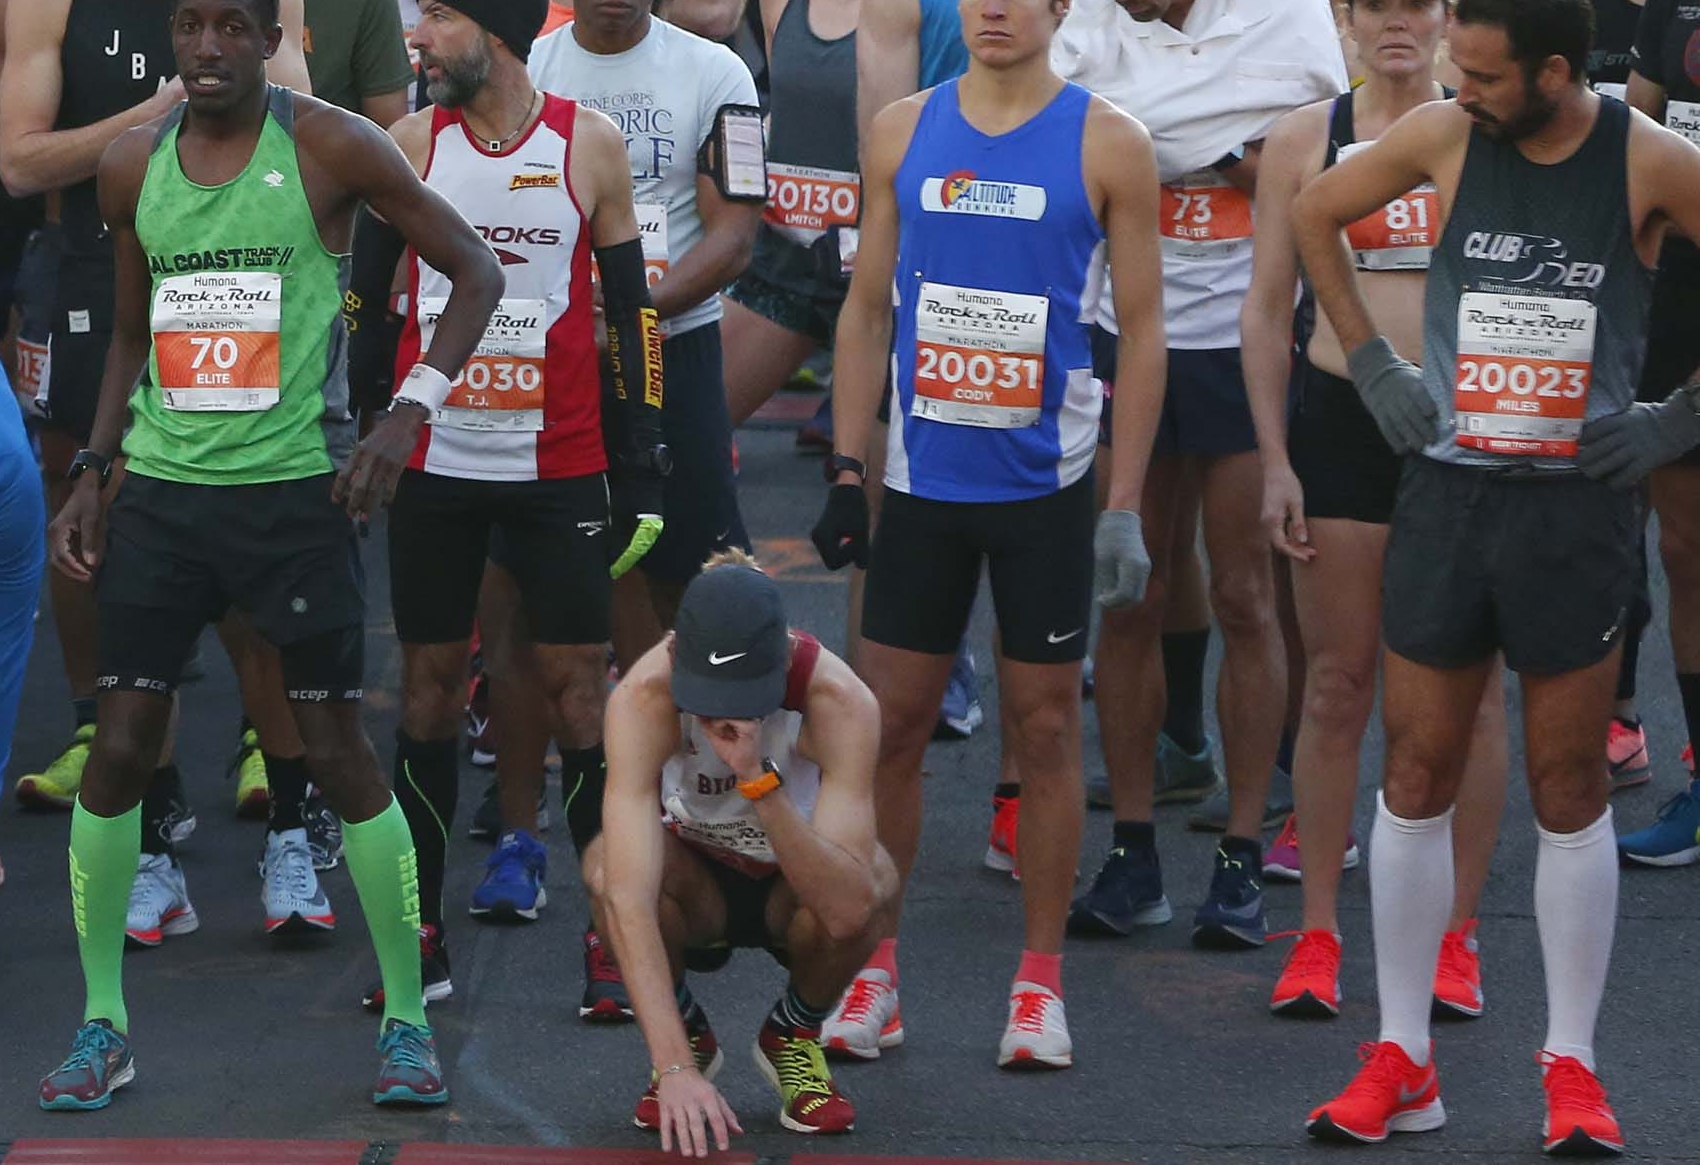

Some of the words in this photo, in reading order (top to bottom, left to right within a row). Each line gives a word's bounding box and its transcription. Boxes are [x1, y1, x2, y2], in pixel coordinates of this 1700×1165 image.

[105, 30, 120, 56] J
[132, 53, 146, 80] B
[581, 95, 609, 109] RINE
[611, 92, 654, 107] CORPS
[610, 109, 674, 134] ORIC
[626, 137, 675, 180] LF
[512, 175, 559, 186] PowerBar
[766, 180, 855, 216] 20130
[1172, 192, 1213, 223] 73
[1385, 198, 1429, 229] 81
[1175, 224, 1210, 238] ELITE
[1389, 232, 1429, 245] ELITE
[244, 247, 280, 257] TRACK
[1464, 232, 1524, 262] CLUB
[151, 255, 174, 274] AL
[174, 248, 244, 272] COAST
[244, 256, 273, 267] CLUB
[194, 277, 237, 286] Humana
[957, 292, 1003, 306] Humana
[939, 317, 1019, 331] ARIZONA
[948, 336, 1007, 350] MARATHON
[190, 337, 238, 369] 70
[918, 347, 1038, 389] 20031
[197, 373, 230, 384] ELITE
[452, 362, 540, 391] 030
[1457, 361, 1587, 399] 20023
[467, 395, 489, 406] T.J.
[955, 388, 994, 401] CODY
[1496, 399, 1541, 412] MILES
[300, 690, 329, 701] cep
[700, 820, 746, 831] Humana
